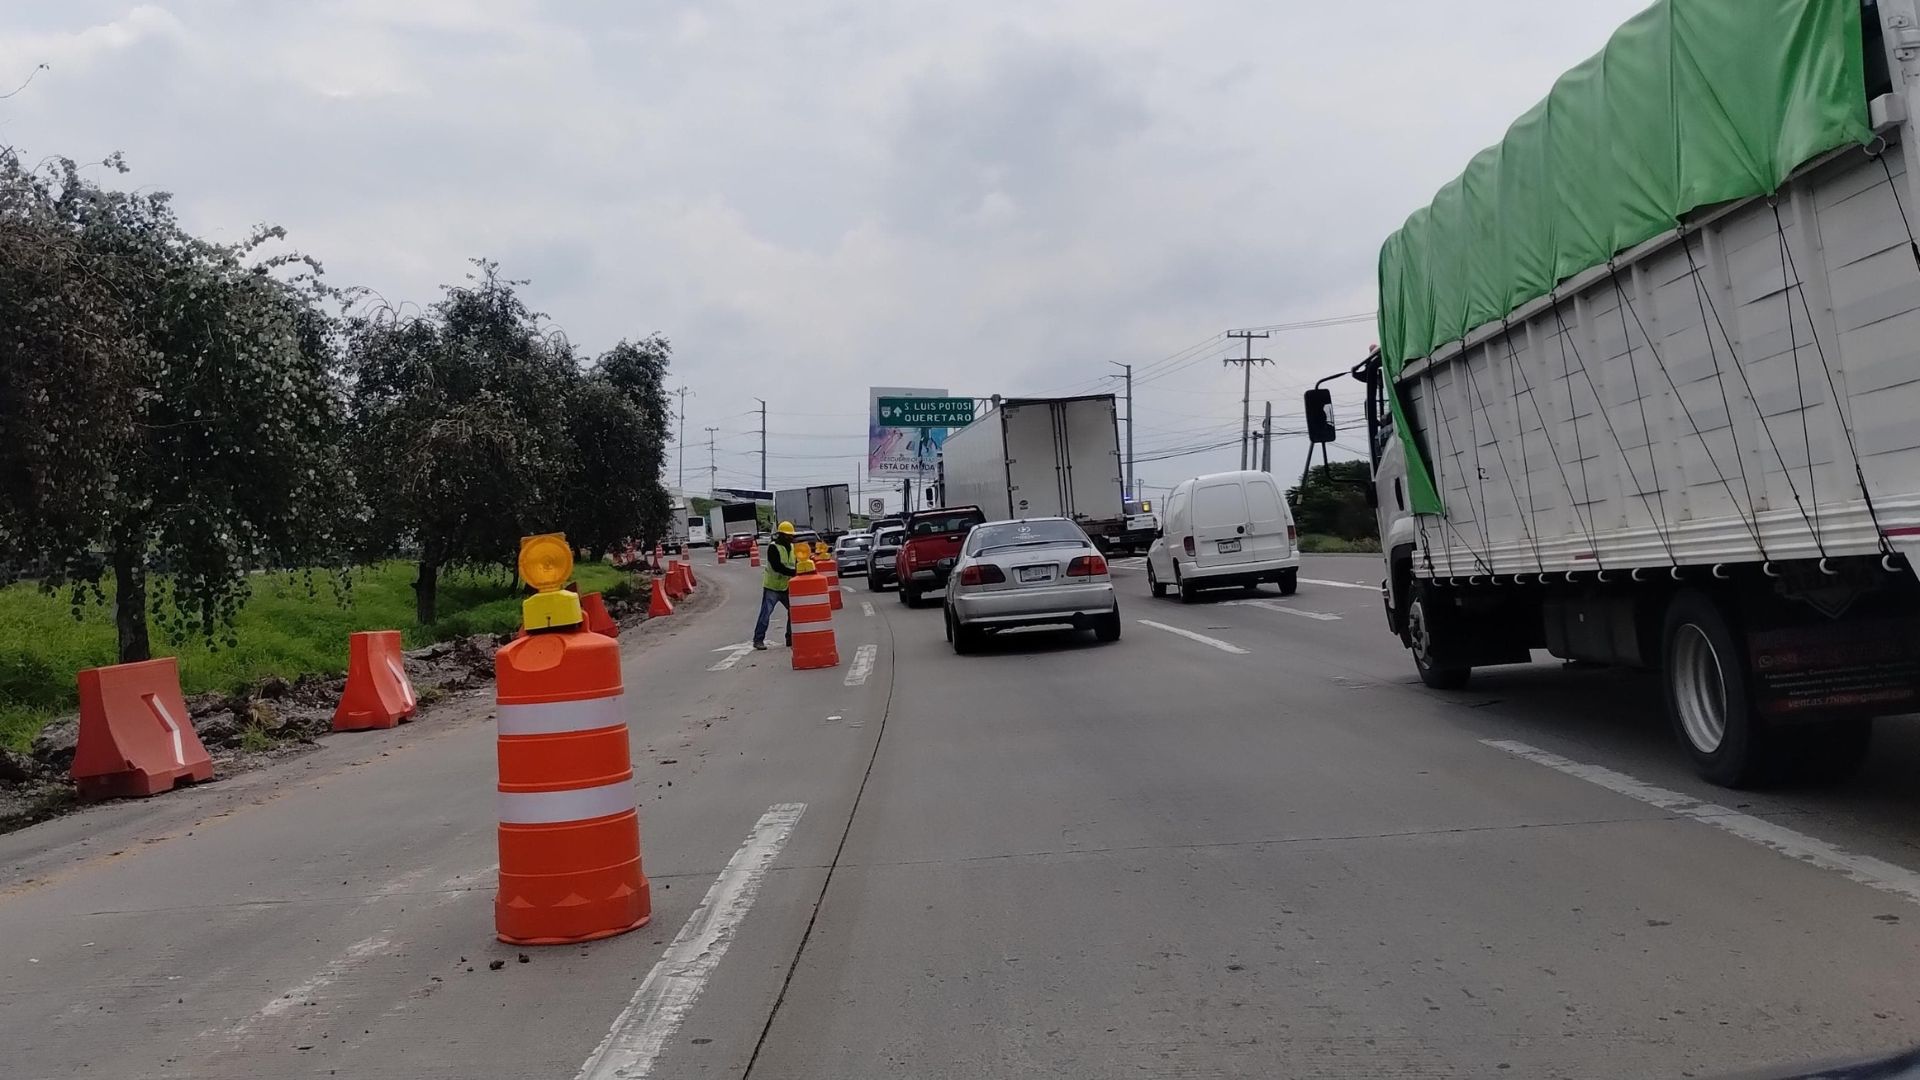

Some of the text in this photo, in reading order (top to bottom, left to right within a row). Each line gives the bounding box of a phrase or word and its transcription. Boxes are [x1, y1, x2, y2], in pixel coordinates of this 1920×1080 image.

[914, 402, 936, 411] LUIS
[938, 402, 972, 411] POTOSI
[904, 413, 972, 422] QUERETARO
[879, 461, 898, 470] ESTÁ
